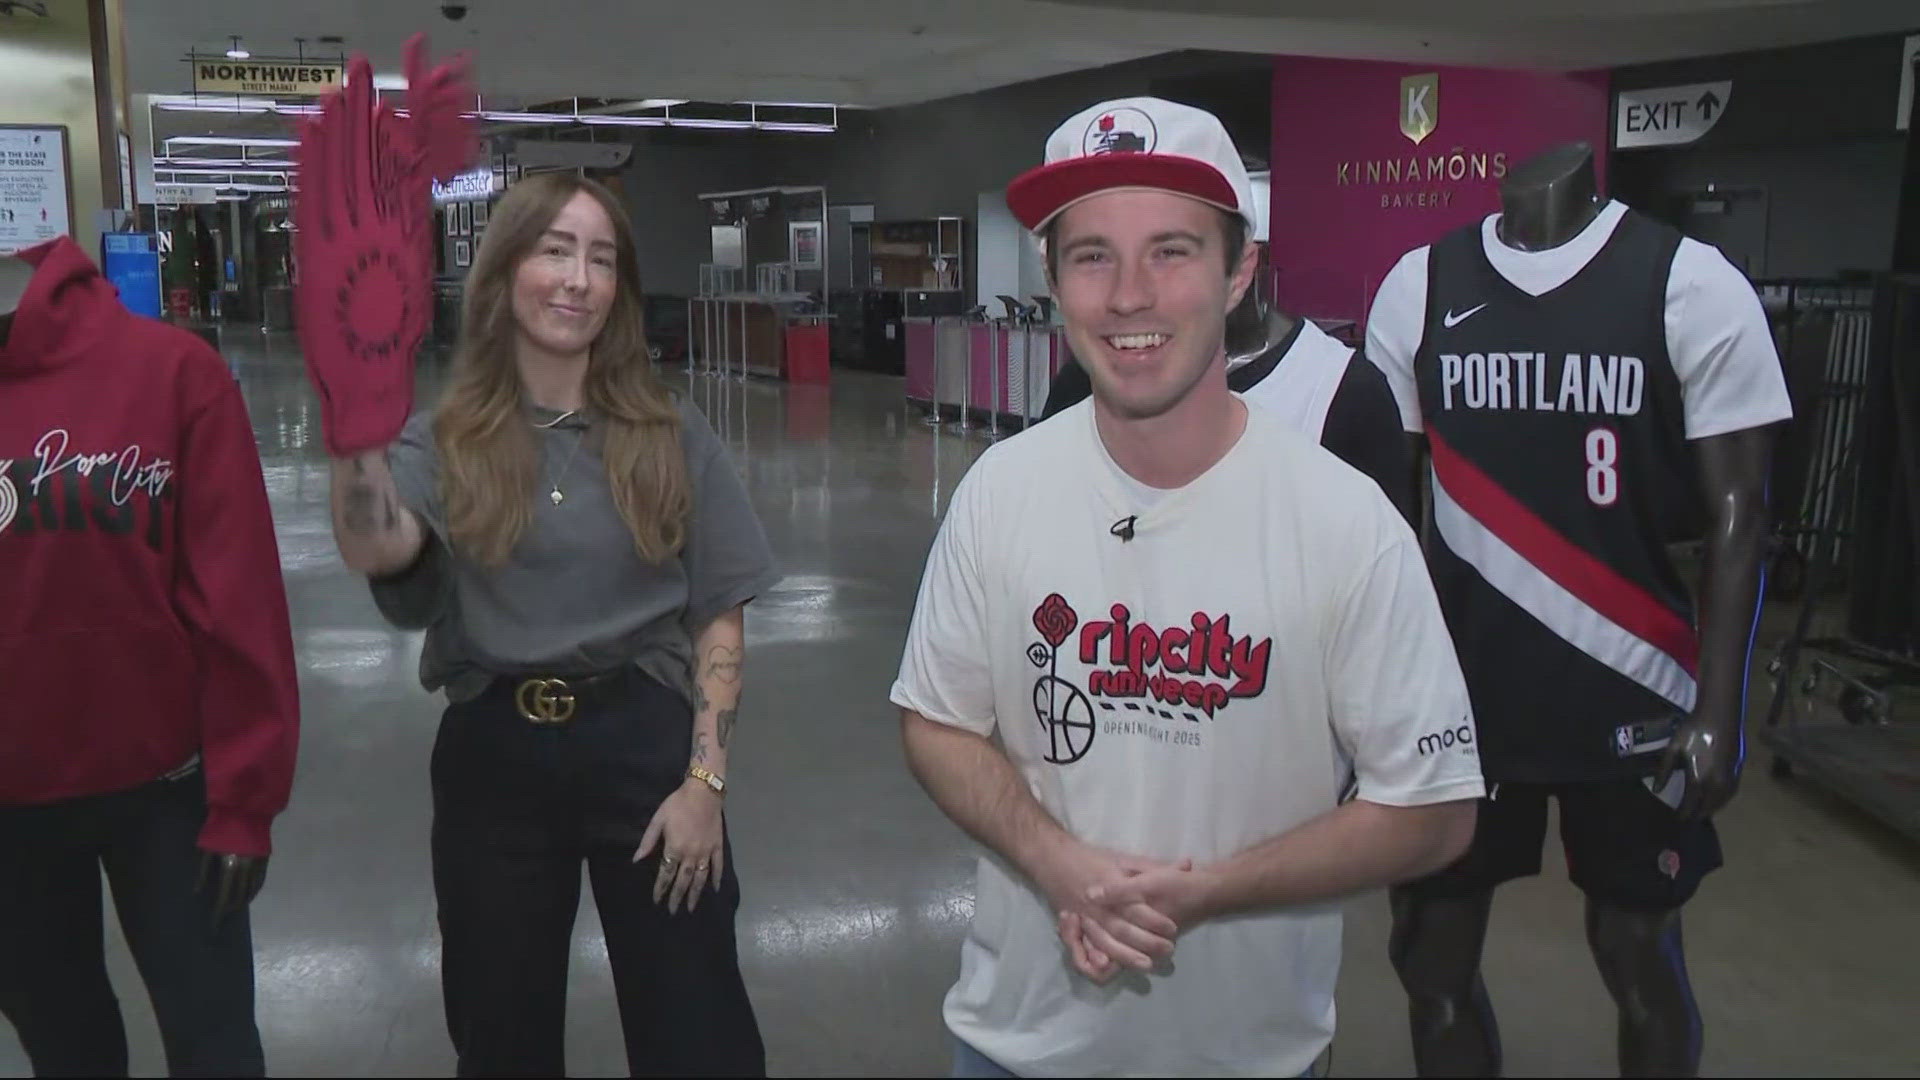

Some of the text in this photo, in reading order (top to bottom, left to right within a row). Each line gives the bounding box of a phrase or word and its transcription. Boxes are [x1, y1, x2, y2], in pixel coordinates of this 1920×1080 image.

[201, 65, 336, 83] NORTHWEST
[242, 83, 297, 92] STREET MARKET
[1407, 85, 1430, 125] K
[1626, 101, 1688, 132] EXIT
[25, 151, 47, 159] STATE
[1381, 192, 1453, 208] BAKERY
[1439, 351, 1645, 417] PORTLAND
[31, 429, 174, 506] Rose City
[1584, 427, 1619, 507] 8
[1173, 730, 1201, 746] 2025
